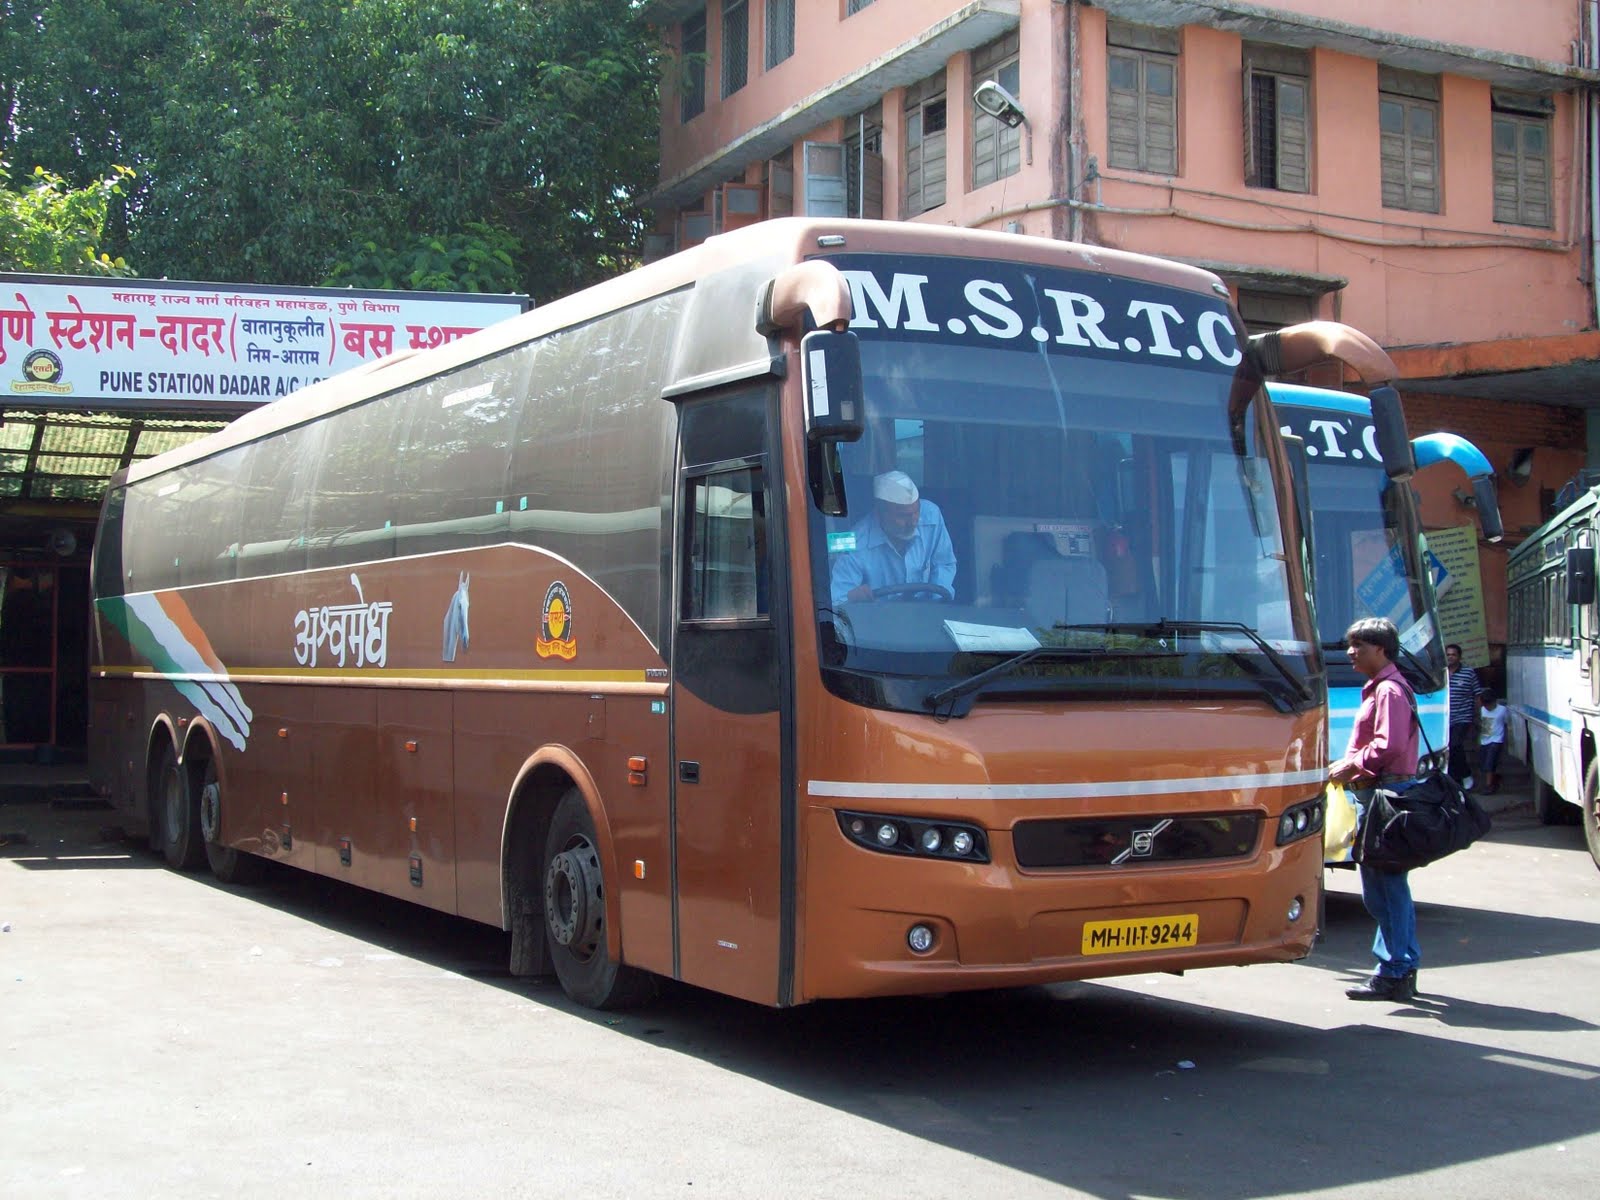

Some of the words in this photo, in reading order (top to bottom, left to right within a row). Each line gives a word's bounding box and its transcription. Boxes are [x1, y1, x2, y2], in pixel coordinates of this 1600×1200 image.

[112, 292, 156, 306] महाराष्ट्र
[161, 294, 190, 305] राज्य
[196, 294, 219, 306] मार्ग
[224, 295, 270, 309] परिवहन
[338, 300, 357, 315] पुणे
[362, 299, 400, 313] विभाग
[241, 316, 325, 344] वातानुकूलीत
[339, 322, 396, 359] बस
[247, 342, 320, 365] निम-आराम
[100, 371, 142, 393] PUNE
[148, 371, 214, 395] STATION
[220, 374, 270, 397] DADAR
[275, 376, 299, 397] A/C
[293, 573, 393, 668] अश्वमेध
